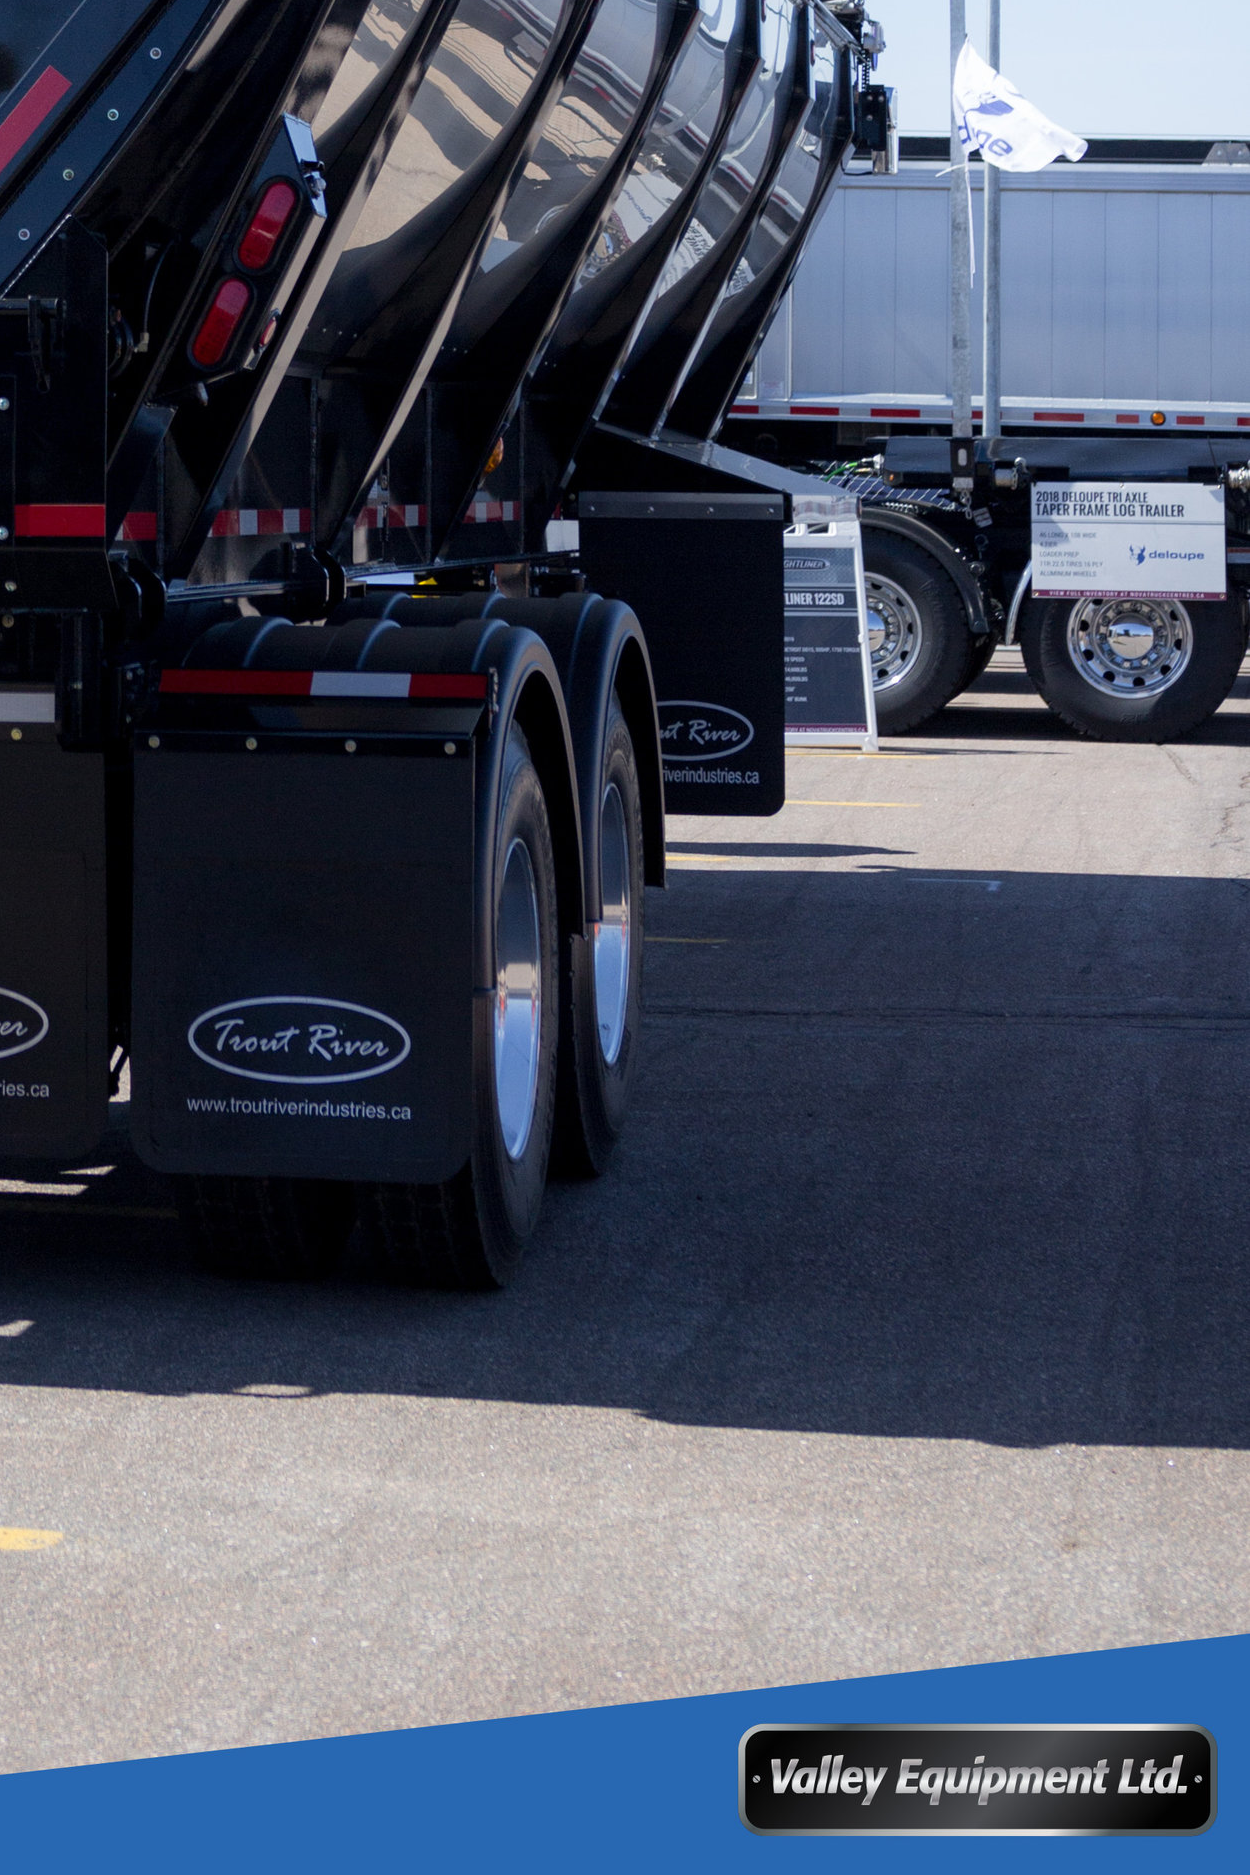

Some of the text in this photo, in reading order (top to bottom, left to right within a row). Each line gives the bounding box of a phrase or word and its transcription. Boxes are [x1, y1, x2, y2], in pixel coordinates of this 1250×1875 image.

[1036, 491, 1148, 503] 2018 DELOUPE TRI AXLE
[1035, 503, 1185, 517] TAPER FRAME LOG TRAILER
[1148, 550, 1205, 561] deloupe
[784, 592, 845, 605] LINER 122SD
[688, 719, 741, 745] River
[214, 1019, 389, 1061] Trout River
[186, 1094, 412, 1120] www.troutriverindustries.ca
